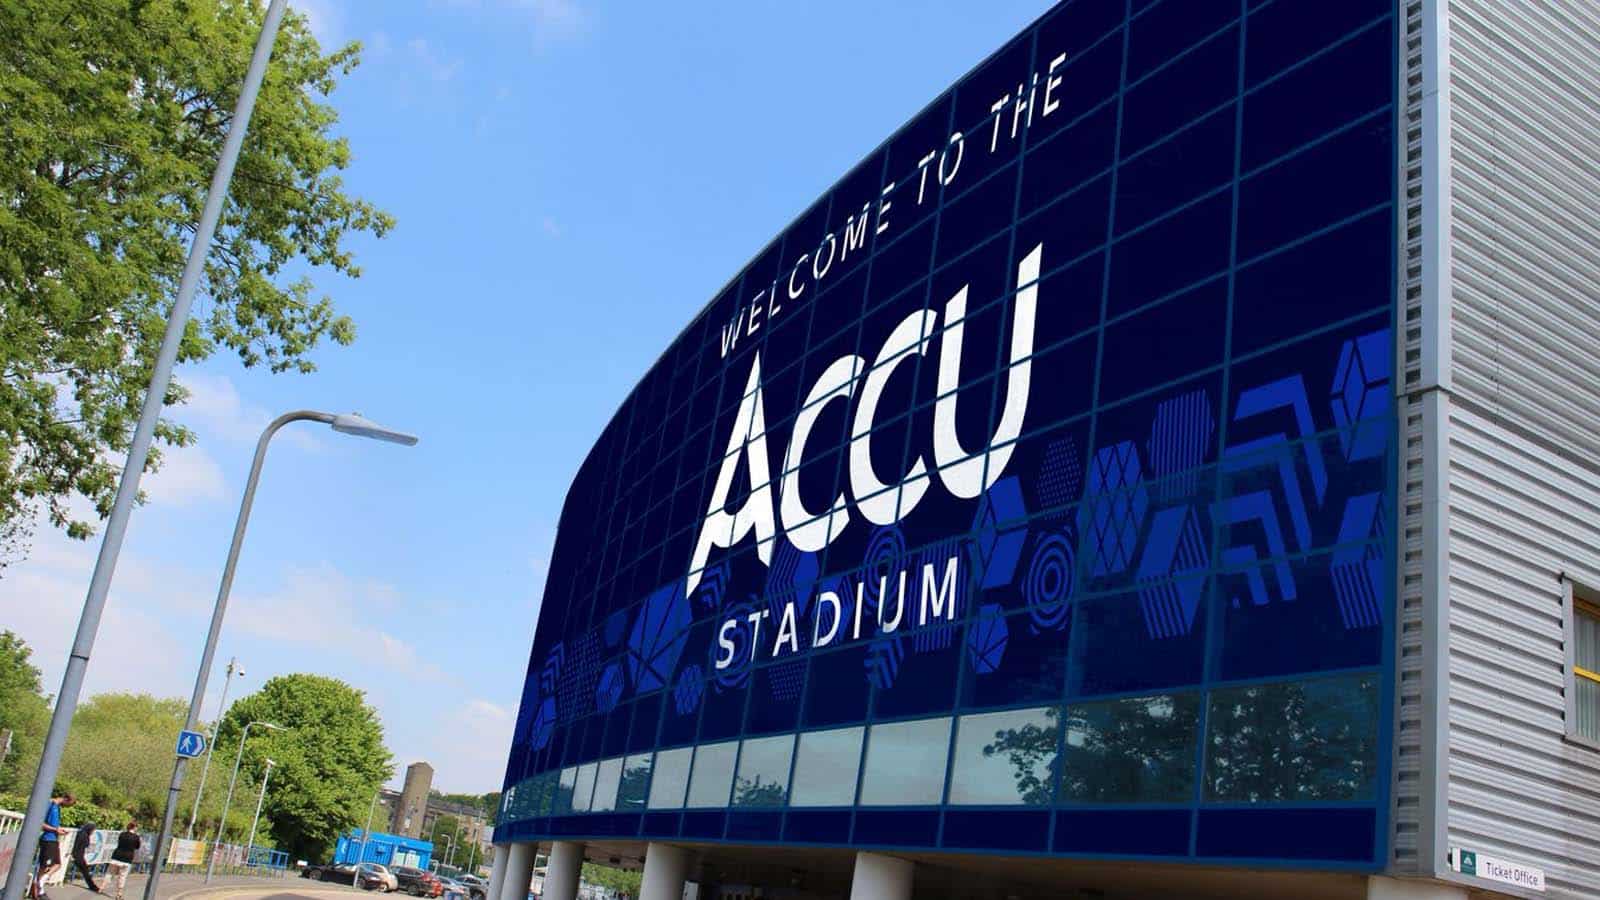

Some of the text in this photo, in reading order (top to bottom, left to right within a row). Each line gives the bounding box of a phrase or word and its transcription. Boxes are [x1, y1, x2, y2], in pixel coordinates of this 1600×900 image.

[721, 52, 1066, 358] WELCOME TO THE
[687, 242, 1042, 599] ACCU
[715, 557, 958, 668] STADIUM
[1486, 862, 1538, 886] Ticket Office
